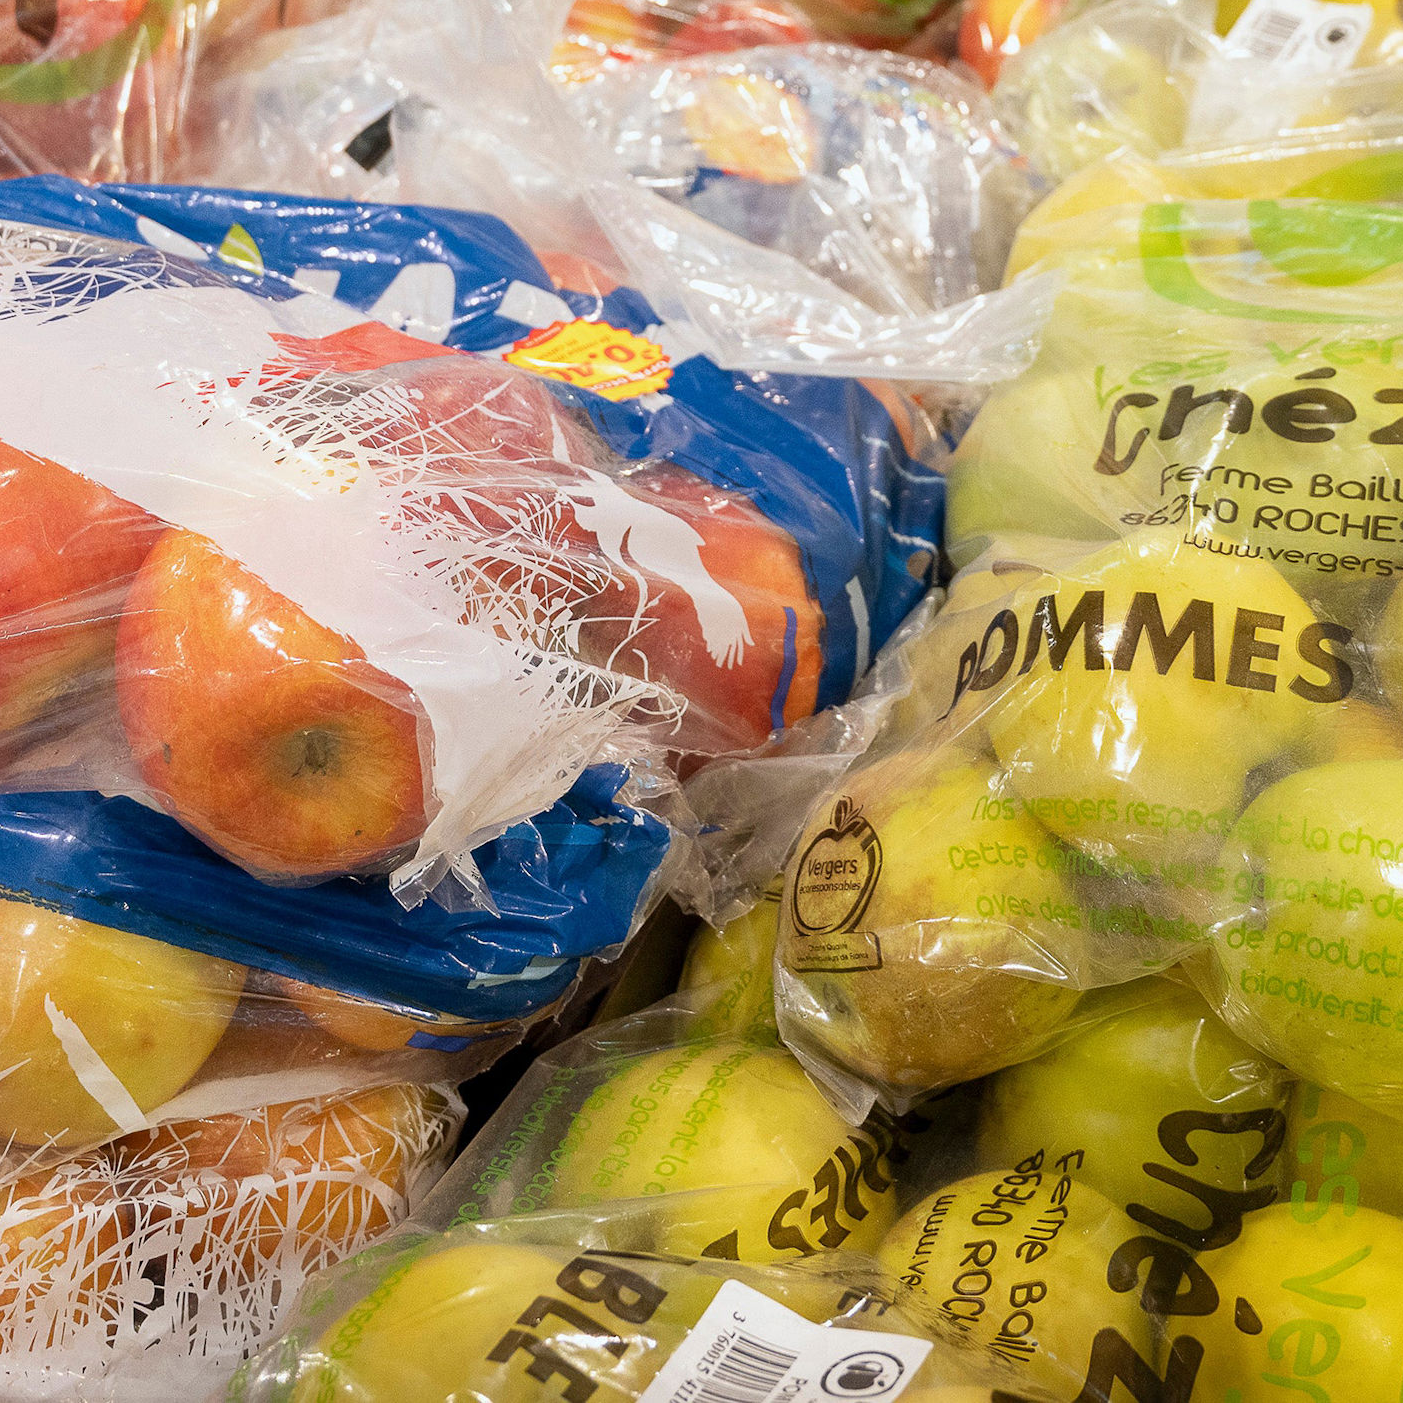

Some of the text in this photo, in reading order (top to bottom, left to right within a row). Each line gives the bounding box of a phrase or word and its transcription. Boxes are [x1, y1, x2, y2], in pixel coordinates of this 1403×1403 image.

[1160, 462, 1293, 496] Ferme
[936, 592, 1355, 721] POMMES
[1020, 794, 1120, 828] vergers
[1301, 816, 1330, 853] la
[807, 856, 859, 881] Vergers
[948, 839, 1030, 873] Cette
[1225, 921, 1266, 951] de
[970, 1147, 1046, 1228] 86340
[1015, 1147, 1086, 1266] Ferme
[732, 1309, 746, 1324] 3
[694, 1329, 737, 1376] 760015
